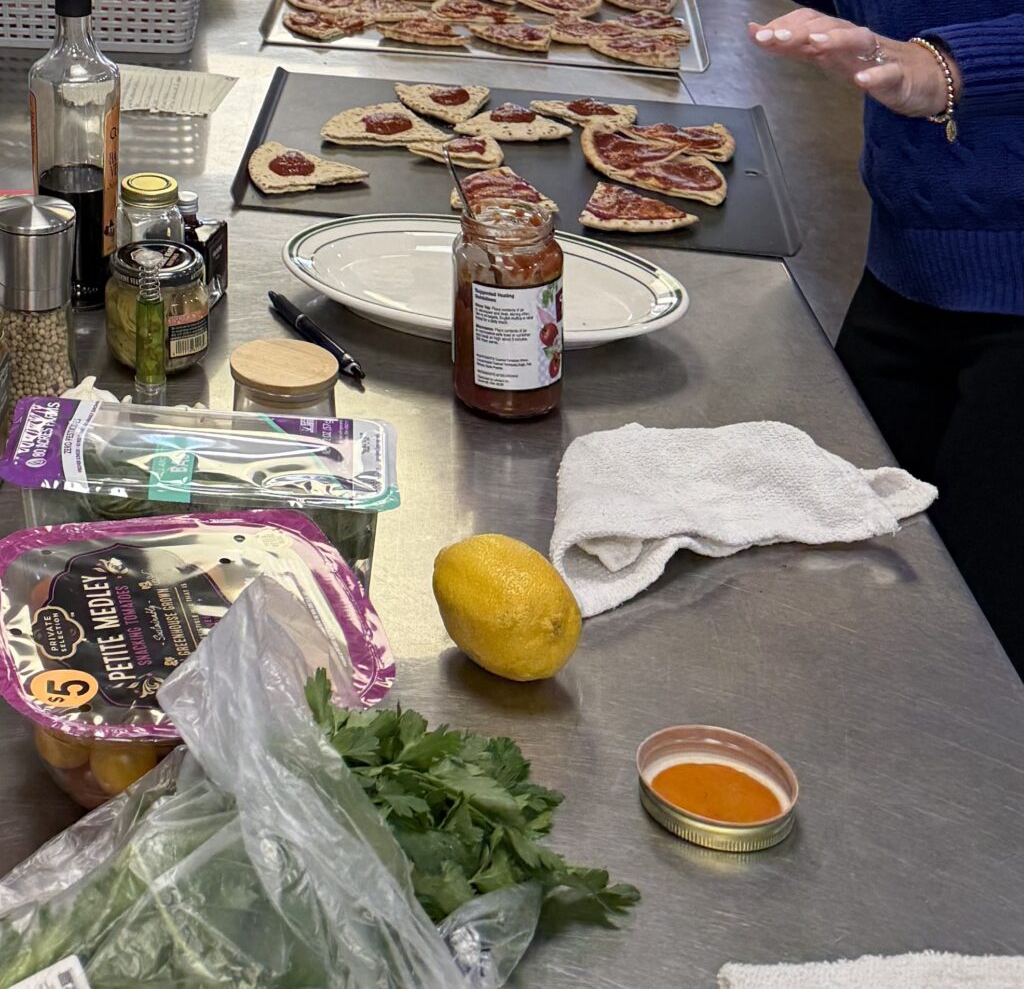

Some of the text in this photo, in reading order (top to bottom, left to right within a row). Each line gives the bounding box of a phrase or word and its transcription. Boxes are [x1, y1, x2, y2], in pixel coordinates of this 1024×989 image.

[44, 615, 58, 651] PRIVATE
[52, 611, 67, 652] SELECTION
[81, 575, 136, 681] PETITE MEDLEY
[115, 585, 152, 666] SNACKING TOMATOES
[156, 587, 191, 657] GREENHOUSE GROWN
[46, 679, 90, 704] $5
